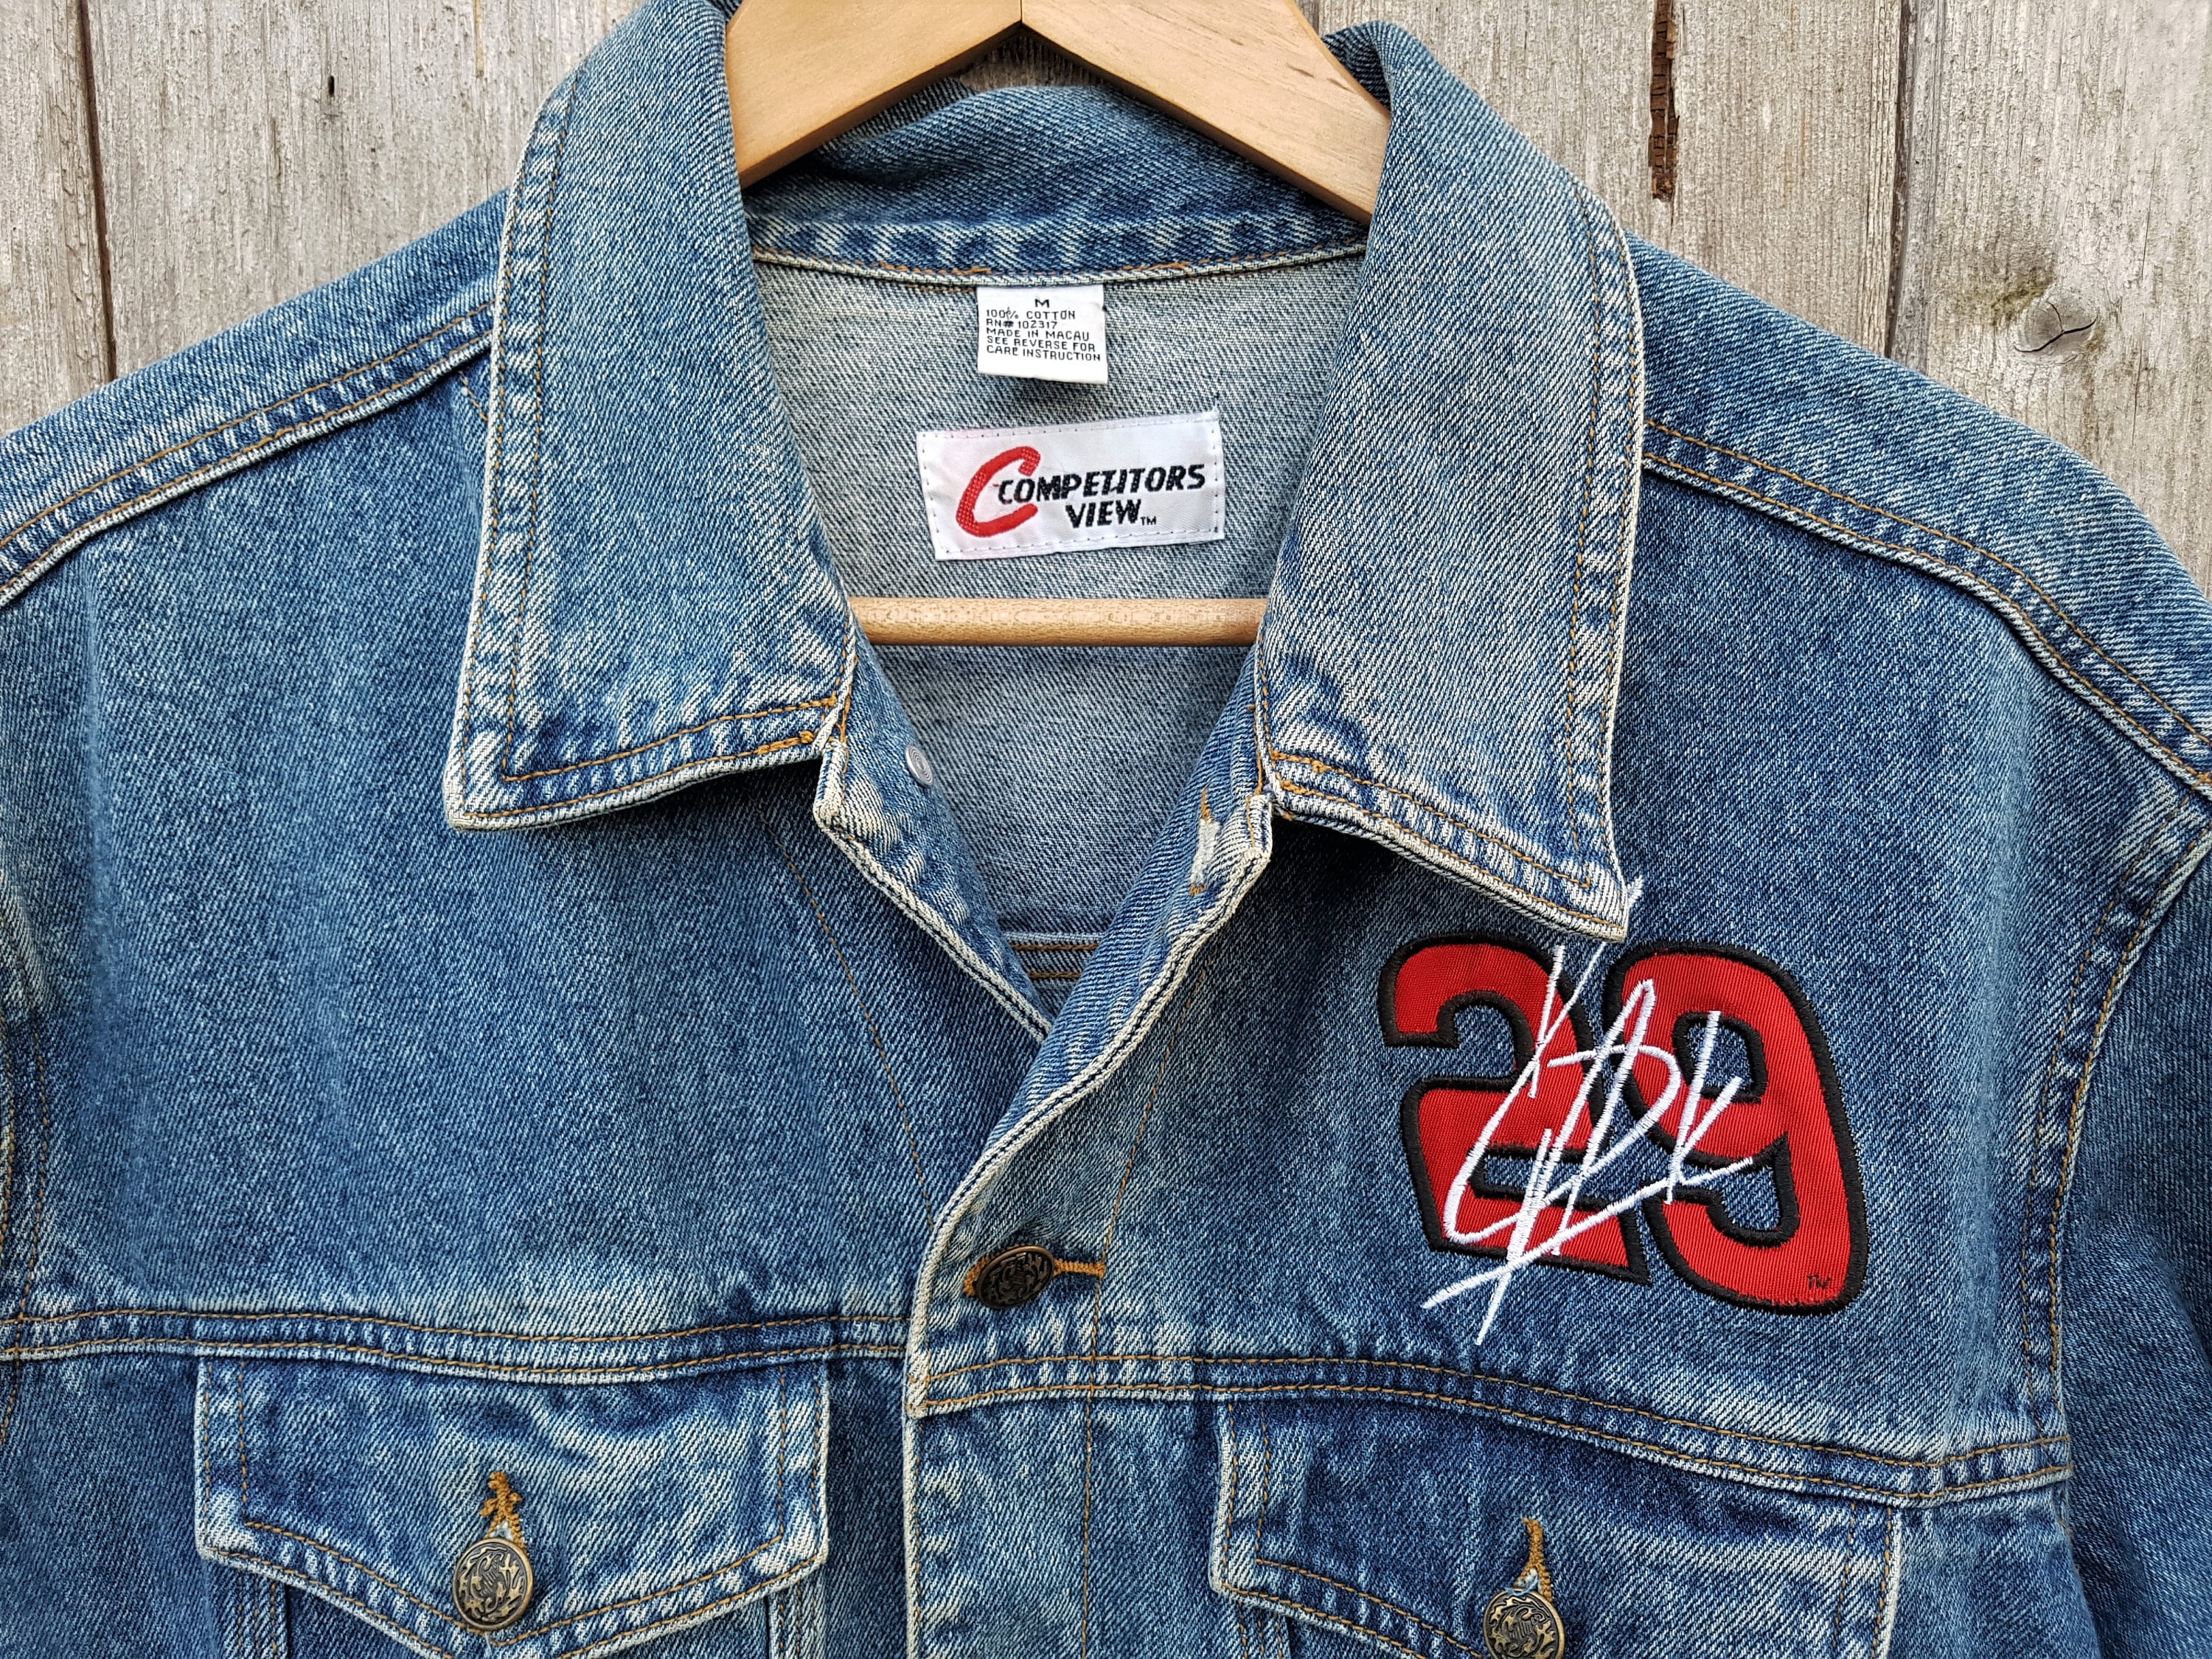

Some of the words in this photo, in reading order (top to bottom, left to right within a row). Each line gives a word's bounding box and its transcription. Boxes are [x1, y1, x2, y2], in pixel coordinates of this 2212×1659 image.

[1034, 299, 1050, 308] M
[986, 309, 1019, 320] 100%
[1026, 310, 1076, 320] COTTON
[986, 318, 1015, 328] RN#
[1018, 320, 1057, 330] 102317
[986, 327, 1021, 338] MADE
[1027, 330, 1039, 338] IN
[1046, 331, 1090, 341] MACAU
[987, 335, 1009, 345] SEE
[1013, 338, 1068, 350] REVERSE
[1073, 342, 1096, 352] FOR
[987, 344, 1018, 356] CARE
[1023, 348, 1101, 361] INSTRUCTION
[998, 463, 1206, 504] COMPETITORS
[1065, 499, 1141, 529] VIEW
[1377, 929, 1871, 1318] 29
